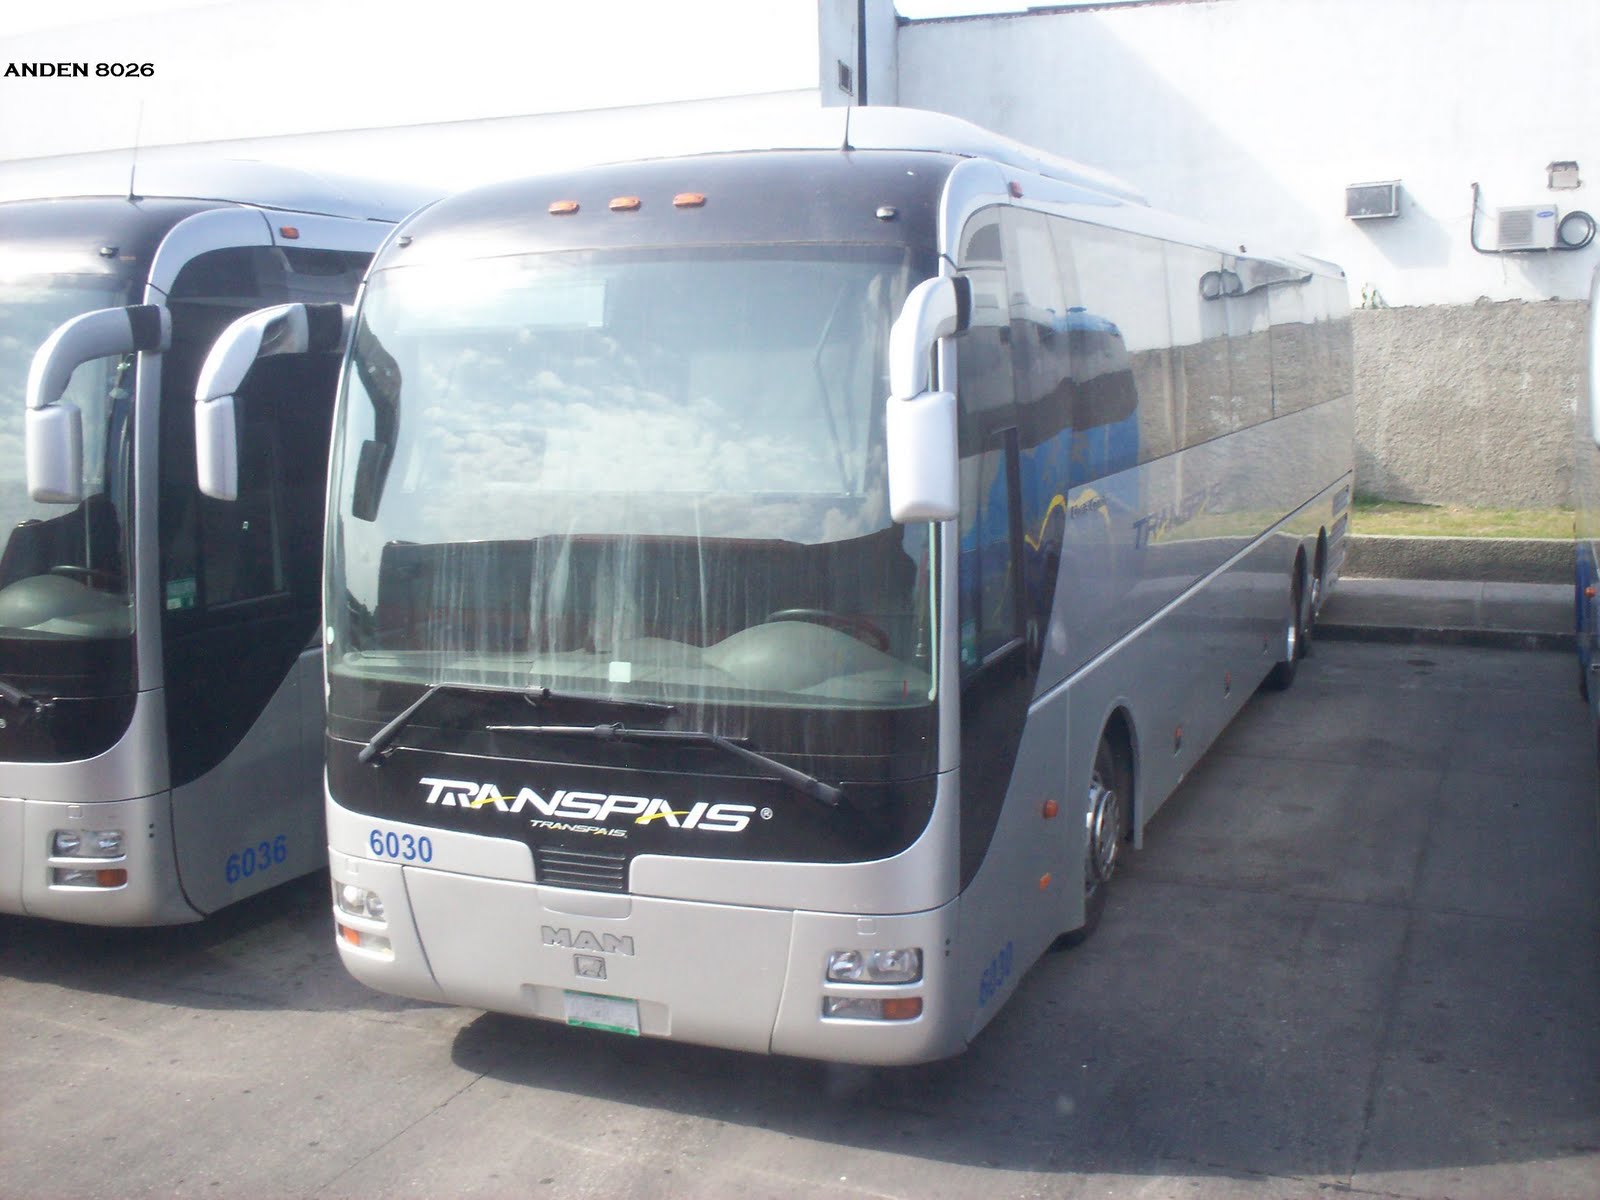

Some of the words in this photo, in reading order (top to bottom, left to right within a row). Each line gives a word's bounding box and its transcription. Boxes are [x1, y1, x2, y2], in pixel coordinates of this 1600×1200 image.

[419, 777, 757, 832] TRANSPAIS
[529, 819, 627, 838] TRANSPAIS
[225, 834, 287, 885] 6036
[369, 829, 433, 863] 6030
[541, 925, 635, 956] MAN
